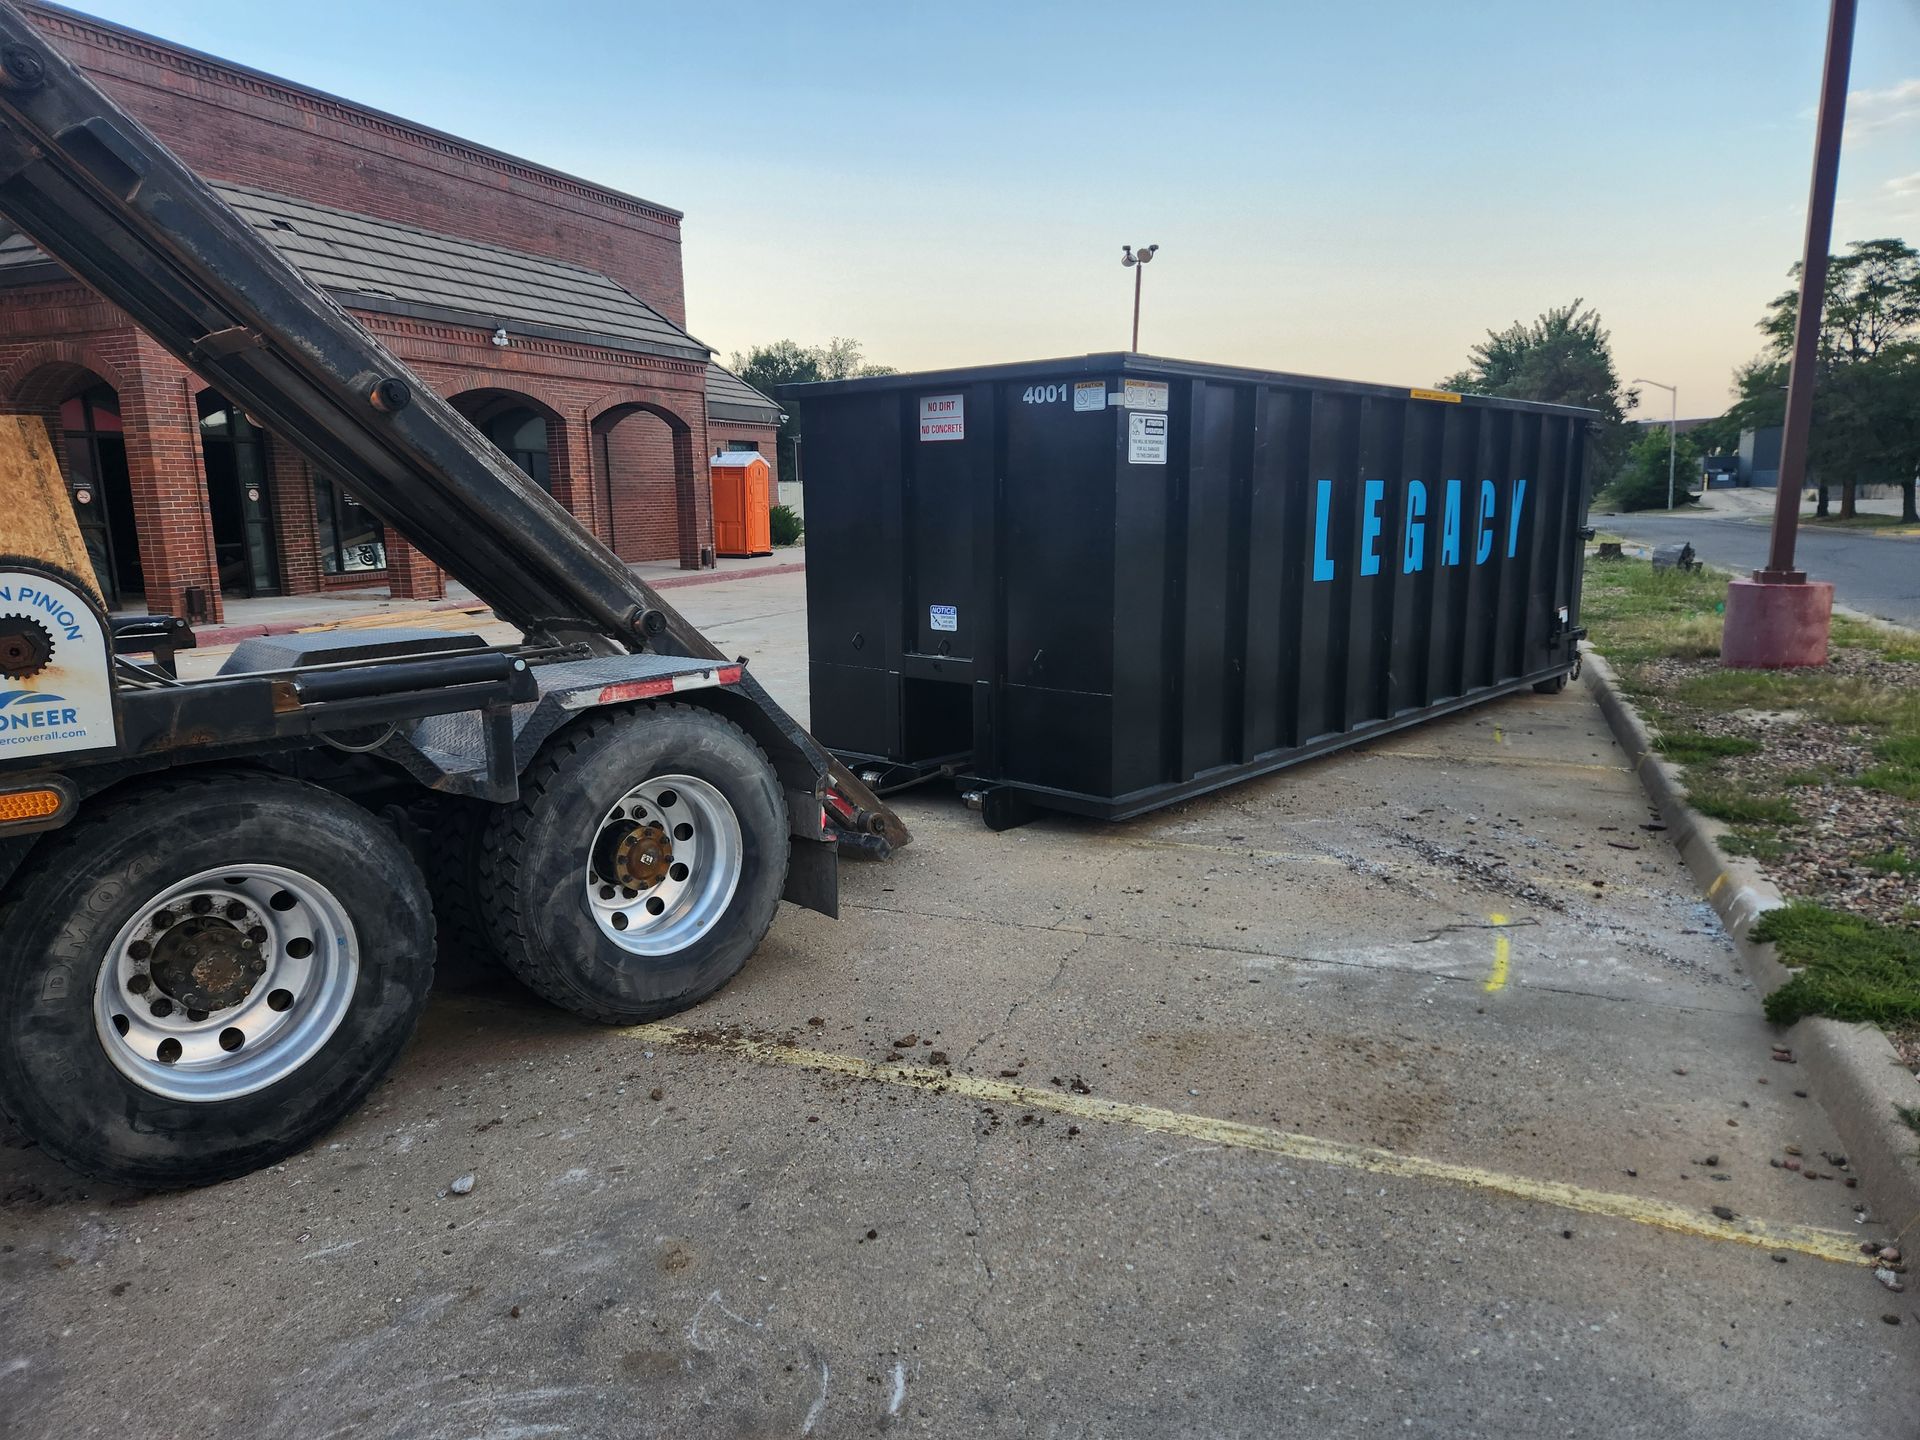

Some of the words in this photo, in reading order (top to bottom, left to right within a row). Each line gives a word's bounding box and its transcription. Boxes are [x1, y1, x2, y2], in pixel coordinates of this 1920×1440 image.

[1022, 384, 1067, 404] 4001
[928, 401, 937, 412] NO
[939, 401, 955, 411] DIRT
[922, 425, 930, 434] NO
[932, 424, 962, 434] CONCRETE
[1313, 479, 1527, 582] LEGACY
[18, 586, 82, 641] PINION
[932, 606, 955, 615] NOTICE
